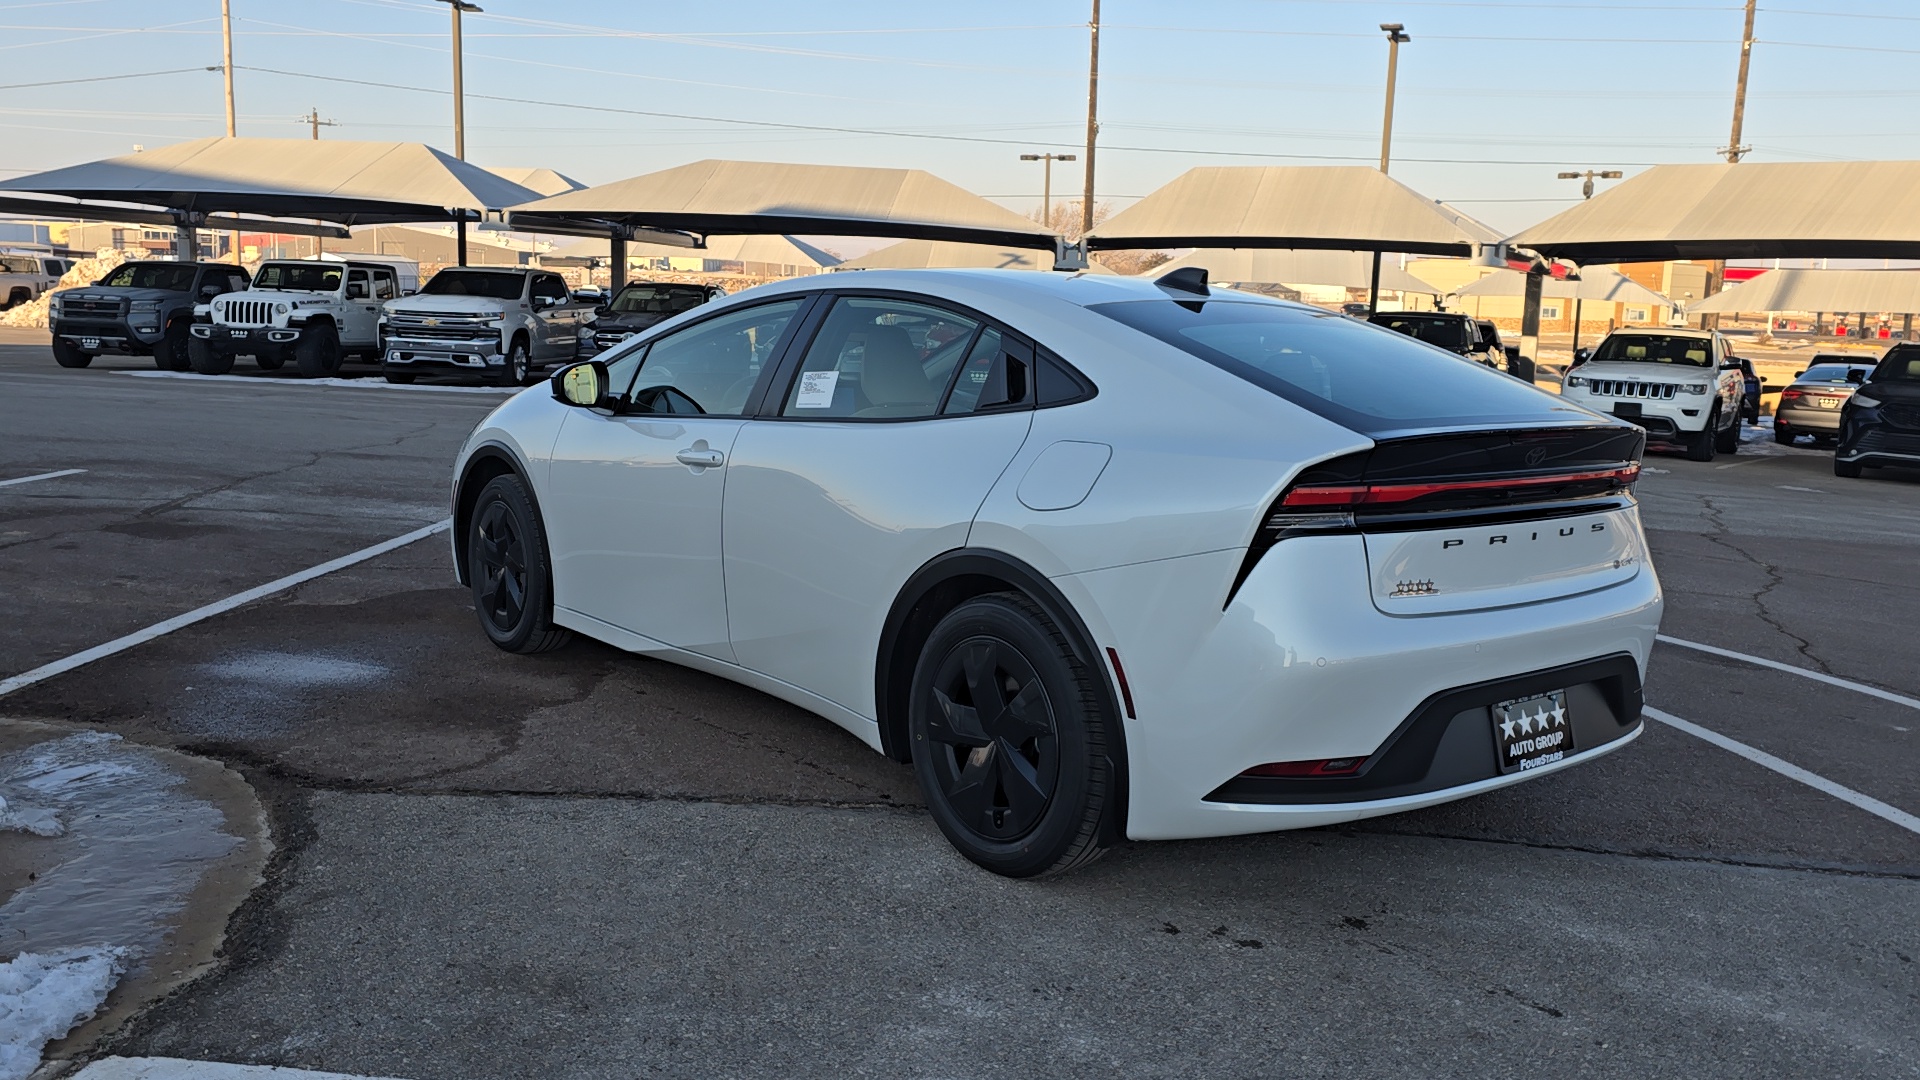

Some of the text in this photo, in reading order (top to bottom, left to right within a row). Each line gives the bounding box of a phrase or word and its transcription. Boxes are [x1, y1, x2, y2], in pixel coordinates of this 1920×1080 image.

[1443, 523, 1604, 549] PRIUS
[1510, 731, 1563, 757] AUTO GROUP
